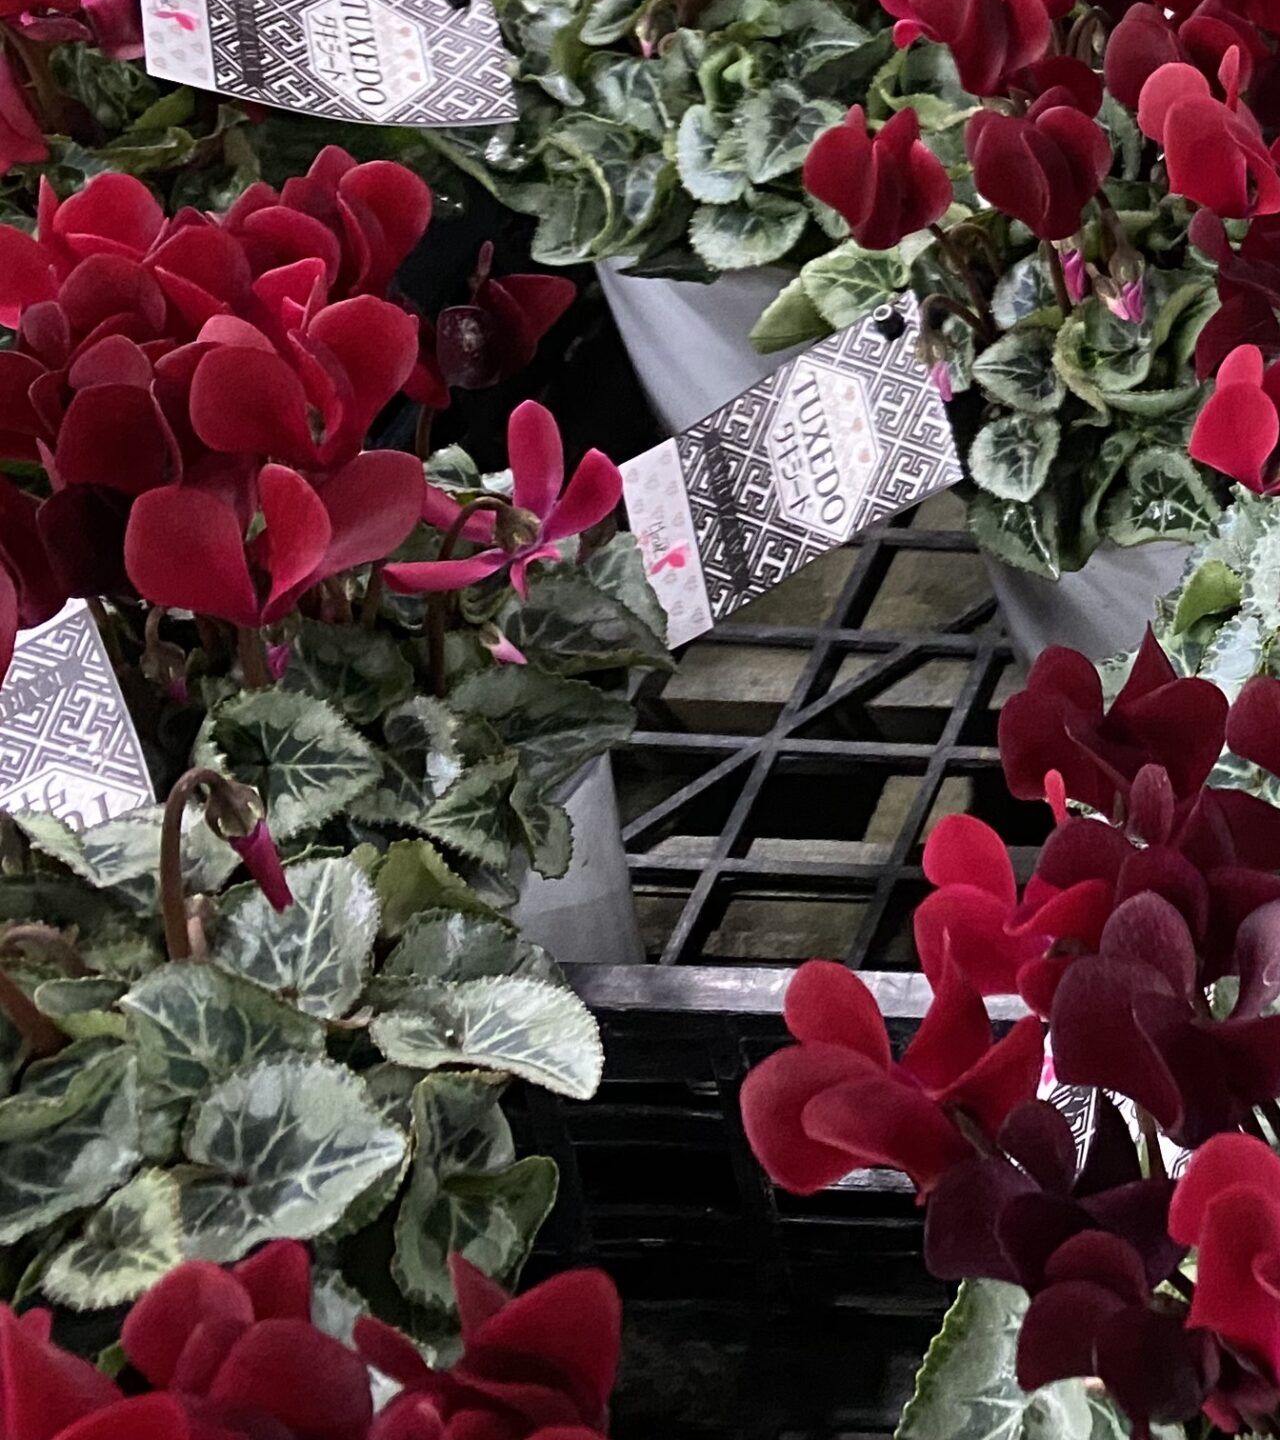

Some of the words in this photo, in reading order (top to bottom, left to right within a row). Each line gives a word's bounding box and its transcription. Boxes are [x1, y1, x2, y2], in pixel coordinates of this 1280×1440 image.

[309, 14, 348, 83] タキシード
[340, 0, 387, 107] TUXEDO
[771, 420, 814, 517] タキシード
[791, 371, 848, 526] TUXEDO
